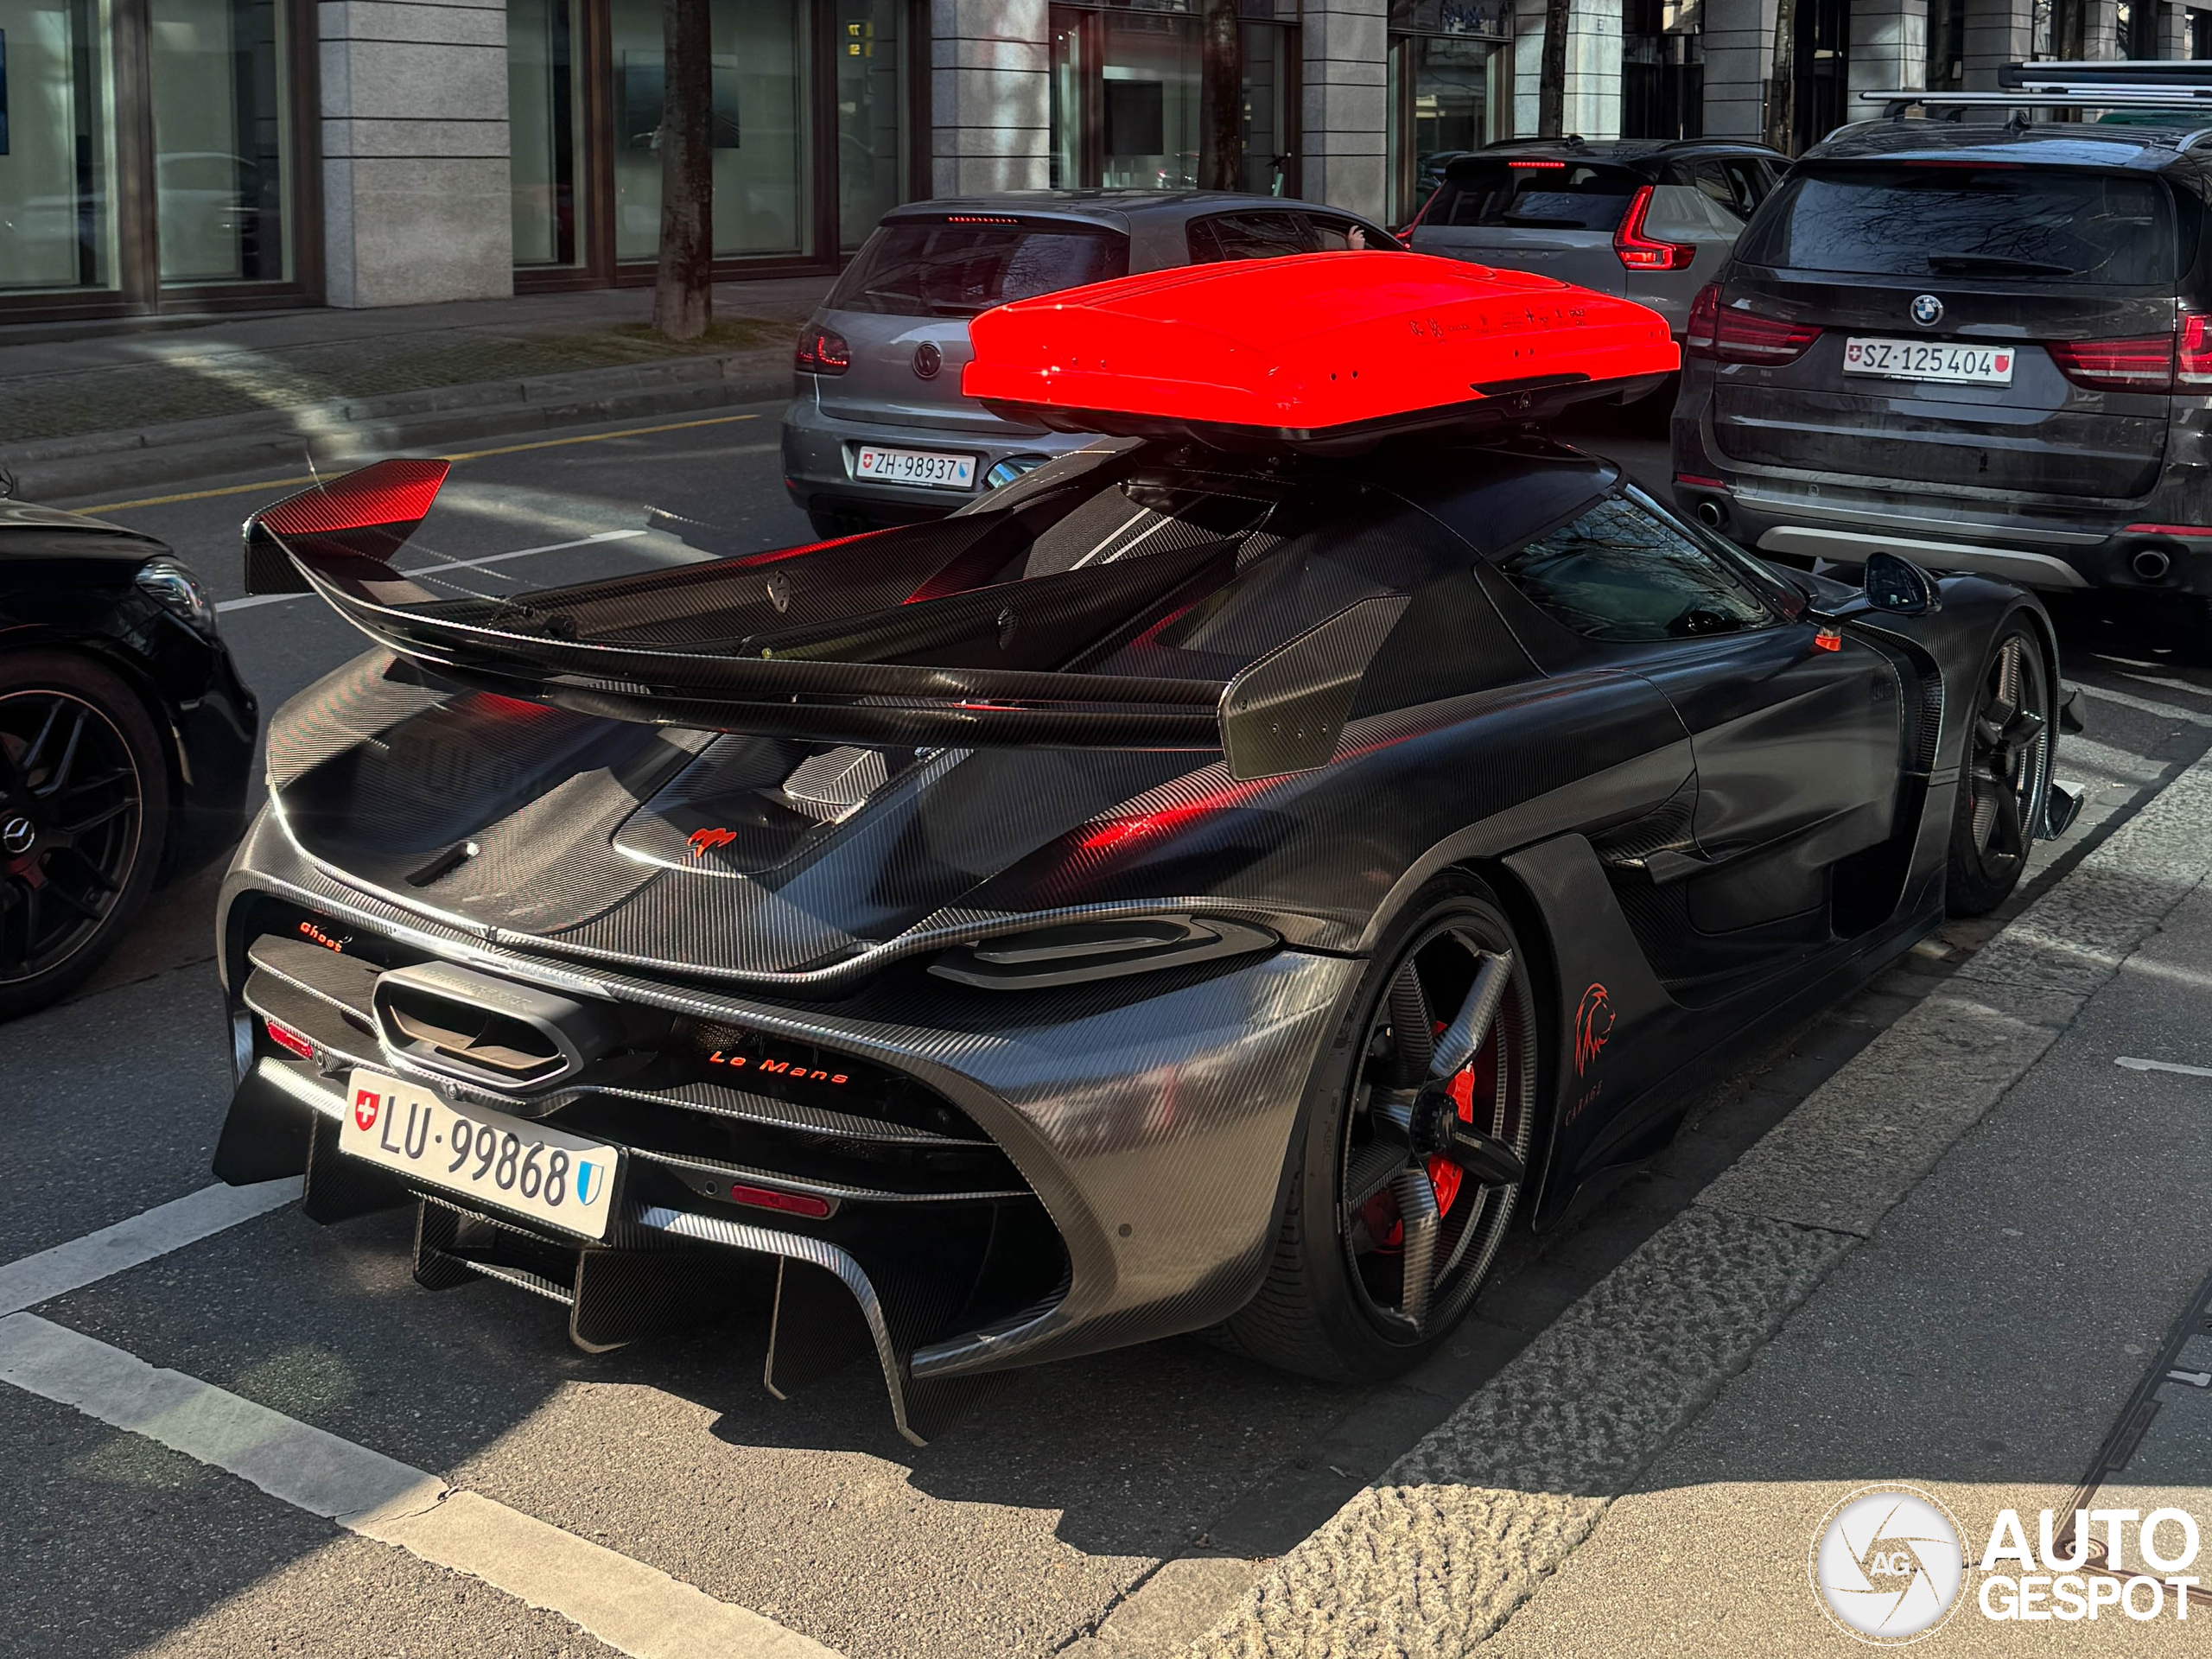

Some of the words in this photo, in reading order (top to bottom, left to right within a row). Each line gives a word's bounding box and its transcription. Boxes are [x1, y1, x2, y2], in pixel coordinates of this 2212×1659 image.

[709, 1051, 747, 1066] Le
[760, 1059, 849, 1084] Mans
[380, 1096, 569, 1206] LU·99868
